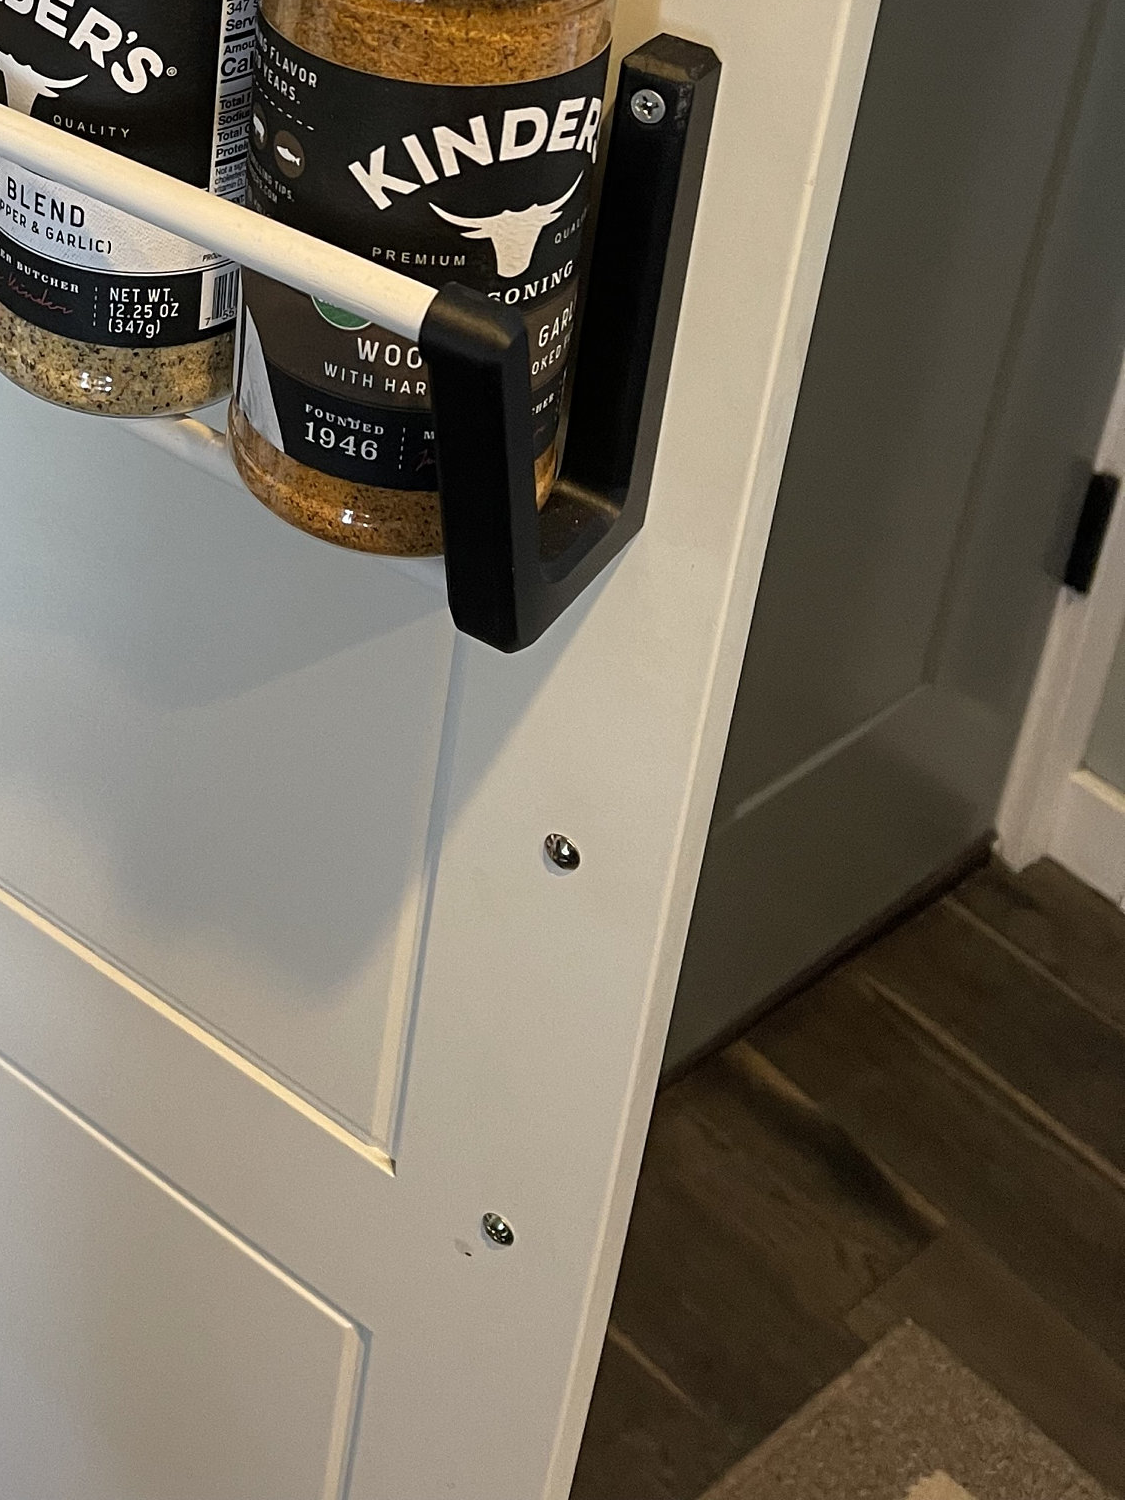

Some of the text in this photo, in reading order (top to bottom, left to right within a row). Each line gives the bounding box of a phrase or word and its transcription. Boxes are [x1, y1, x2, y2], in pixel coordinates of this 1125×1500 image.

[226, 0, 251, 16] 347
[225, 15, 256, 32] Serv
[223, 40, 256, 56] Amou
[270, 46, 317, 90] FLAVOR
[53, 114, 130, 138] QUALITY
[218, 109, 250, 126] Sodiu
[217, 127, 243, 142] Total
[348, 96, 602, 211] KINDER
[7, 175, 85, 229] BLEND
[31, 220, 41, 235] &
[45, 225, 112, 255] GARLIC)
[372, 246, 467, 267] PREMIUM
[17, 259, 80, 294] BUTCHER
[109, 287, 175, 303] NET WT.
[109, 302, 180, 319] 12.25 OZ
[108, 318, 161, 339] (347g)
[324, 361, 374, 389] WITH
[531, 343, 562, 376] OKED
[305, 403, 385, 436] FOUNDED
[304, 420, 378, 461] 1946
